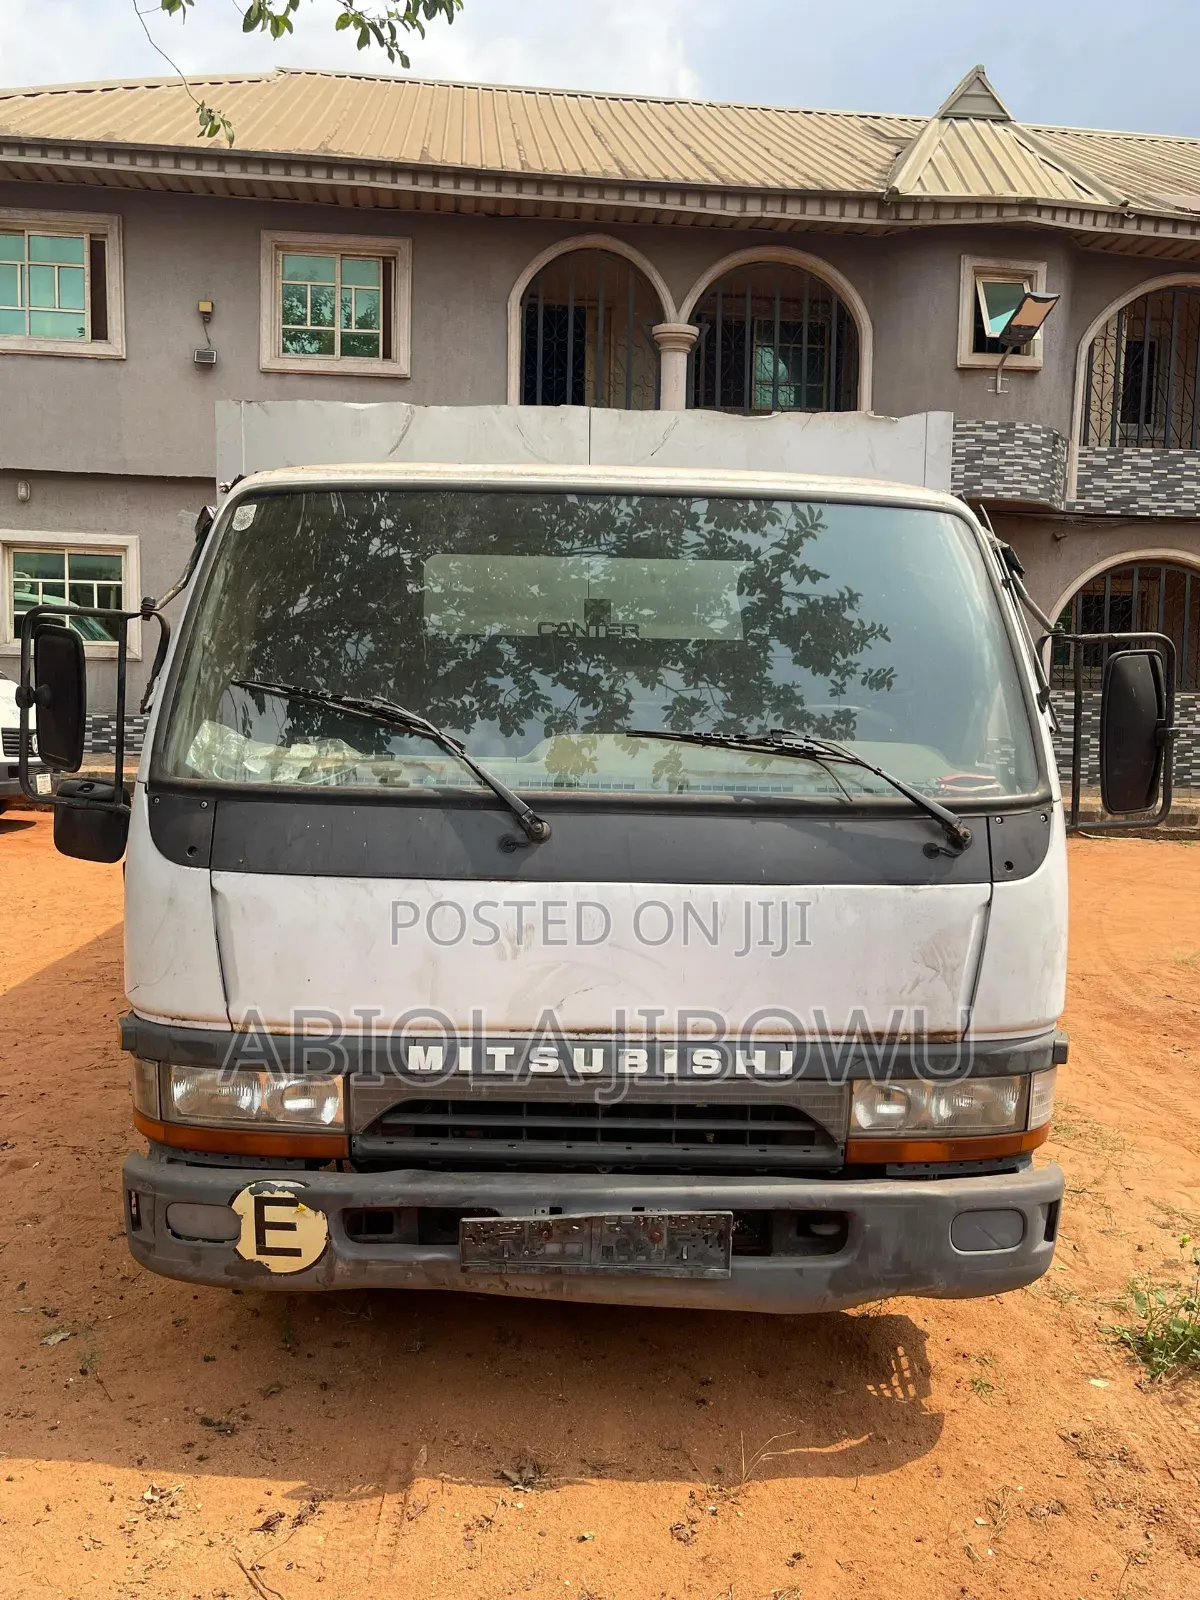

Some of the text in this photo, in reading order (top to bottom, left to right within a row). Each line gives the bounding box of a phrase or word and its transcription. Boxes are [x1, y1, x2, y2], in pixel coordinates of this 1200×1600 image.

[538, 621, 640, 640] CANTER
[407, 1045, 794, 1076] MITSUBISHI
[254, 1197, 302, 1257] E
